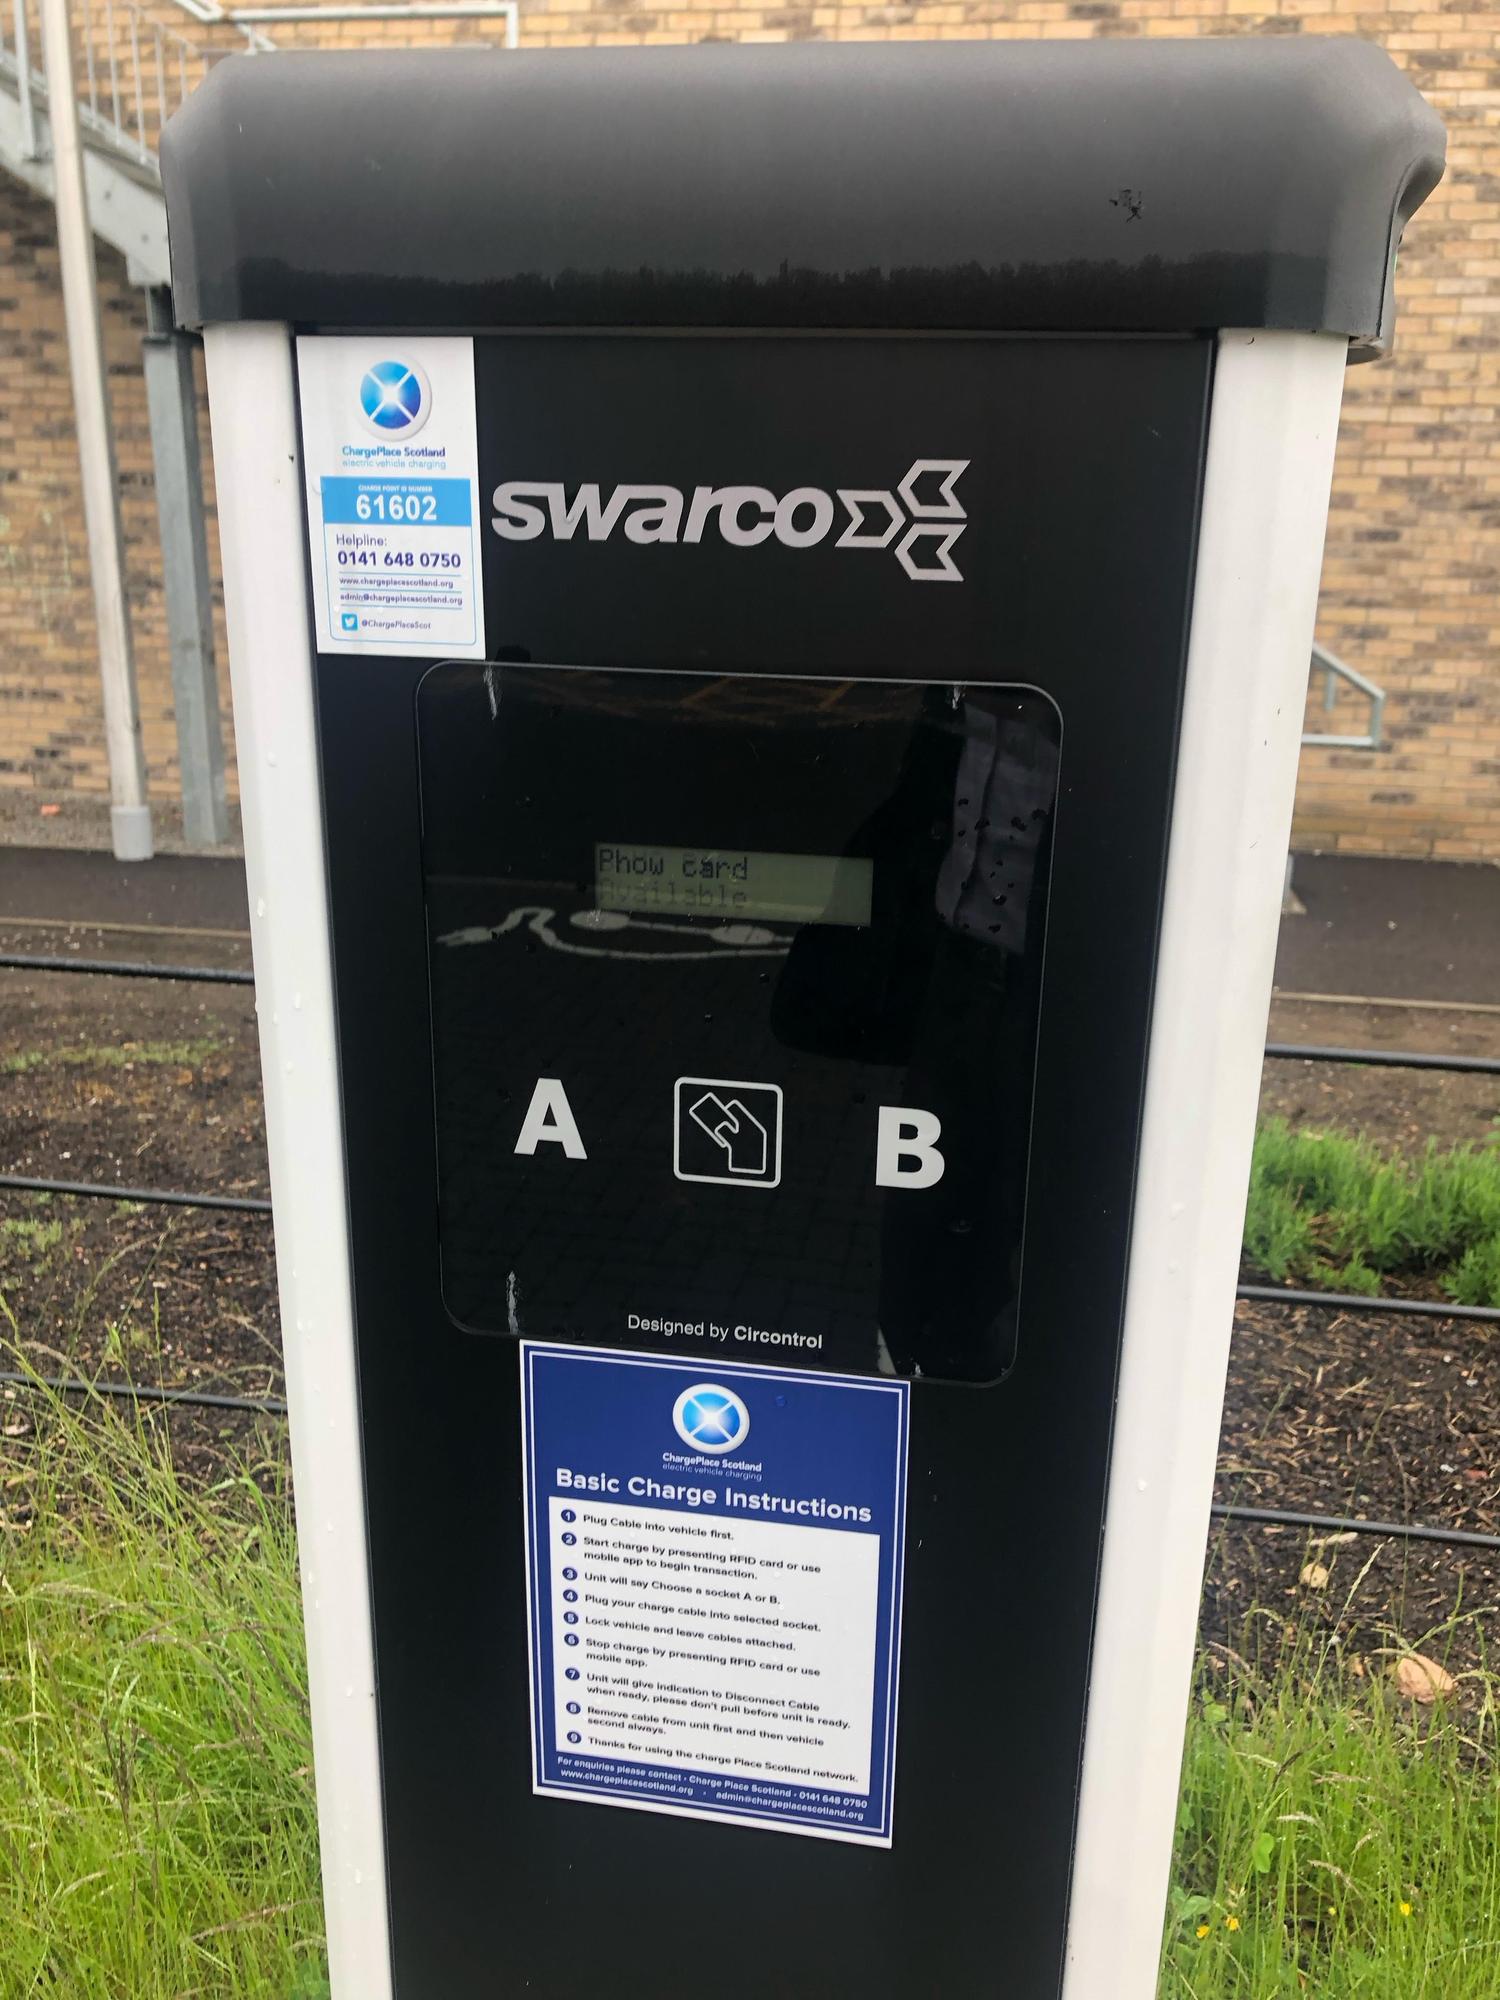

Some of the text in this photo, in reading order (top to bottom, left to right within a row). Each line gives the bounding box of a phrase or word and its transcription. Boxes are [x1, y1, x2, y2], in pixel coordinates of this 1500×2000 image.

[342, 446, 446, 458] ChargePlace Scotland
[342, 459, 446, 470] electric vehicle charging
[356, 494, 437, 520] 61602
[491, 480, 834, 548] swarco
[336, 534, 387, 549] Helpline:
[338, 551, 461, 567] 0141 648 0750
[340, 578, 453, 588] www.chargeplacescotland.org
[340, 593, 462, 605] admin@chargeplacescotland.org
[362, 619, 431, 629] @ChargePlaceScot
[514, 1077, 587, 1159] A
[875, 1105, 945, 1189] B
[628, 1314, 823, 1349] Designed by Circontrol
[662, 1452, 762, 1472] ChargePlace Scotland
[662, 1463, 762, 1482] electric vehicle charging
[556, 1468, 872, 1522] Basic Charge Instructions
[583, 1514, 607, 1526] Plug
[611, 1518, 641, 1529] Cable
[645, 1522, 665, 1532] into
[668, 1525, 707, 1537] vehicle
[710, 1530, 734, 1540] first.
[584, 1537, 609, 1547] Start
[612, 1541, 649, 1553] charge
[652, 1545, 665, 1555] by
[668, 1548, 726, 1563] presenting
[730, 1555, 756, 1564] RFID
[760, 1559, 783, 1568] card
[802, 1565, 821, 1573] use
[584, 1552, 619, 1562] mobile
[623, 1558, 643, 1566] app
[660, 1561, 690, 1572] begin
[694, 1565, 757, 1580] transaction.
[585, 1573, 606, 1583] Unit
[610, 1577, 627, 1585] will
[631, 1580, 648, 1589] say
[652, 1581, 692, 1593] Choose
[705, 1589, 740, 1599] socket
[770, 1596, 780, 1604] B.
[585, 1594, 608, 1605] Plug
[612, 1600, 634, 1608] your
[638, 1602, 674, 1614] charge
[678, 1606, 706, 1617] cable
[710, 1611, 730, 1620] into
[734, 1614, 778, 1626] selected
[783, 1620, 821, 1632] socket.
[585, 1616, 610, 1627] Lock
[613, 1622, 650, 1632] vehicle
[654, 1626, 673, 1635] and
[676, 1629, 704, 1639] leave
[708, 1633, 742, 1644] cables
[746, 1638, 796, 1651] attached.
[586, 1638, 610, 1649] Stop
[613, 1642, 649, 1654] charge
[653, 1647, 665, 1656] by
[669, 1652, 726, 1665] presenting
[730, 1658, 756, 1668] RFID
[760, 1662, 783, 1671] card
[802, 1668, 820, 1676] use
[586, 1652, 648, 1667] mobile app.
[587, 1673, 608, 1683] Unit
[612, 1677, 629, 1685] will
[632, 1680, 653, 1689] give
[657, 1683, 708, 1696] indication
[712, 1691, 722, 1699] to
[725, 1691, 786, 1707] Disconnect
[789, 1701, 820, 1711] Cable
[587, 1686, 615, 1696] when
[618, 1692, 649, 1702] ready,
[653, 1695, 687, 1706] please
[691, 1699, 717, 1710] don't
[721, 1704, 740, 1713] pull
[744, 1707, 778, 1718] before
[782, 1712, 803, 1721] unit
[818, 1717, 850, 1729] ready.
[587, 1706, 628, 1719] Remove
[632, 1713, 659, 1723] cable
[663, 1717, 686, 1726] from
[690, 1721, 710, 1730] unit
[713, 1723, 732, 1733] first
[736, 1728, 756, 1736] and
[760, 1731, 783, 1741] then
[787, 1734, 824, 1746] vehicle
[587, 1718, 666, 1735] second always.
[588, 1737, 626, 1749] Thanks
[629, 1743, 642, 1751] for
[645, 1746, 673, 1757] using
[676, 1750, 692, 1758] the
[695, 1753, 735, 1765] charge
[734, 1755, 761, 1768] Place
[765, 1762, 810, 1775] Scotland
[813, 1769, 858, 1782] network.
[558, 1757, 572, 1765] For
[574, 1760, 615, 1772] enquiries
[617, 1766, 645, 1776] please
[648, 1771, 681, 1781] contact
[689, 1776, 721, 1787] Charge
[725, 1780, 749, 1791] Place
[752, 1784, 791, 1797] Scotland
[800, 1791, 820, 1801] 0141
[561, 1769, 693, 1795] www.chargeplacescotland.org
[716, 1792, 864, 1821] admin@chargeplacescotland.org
